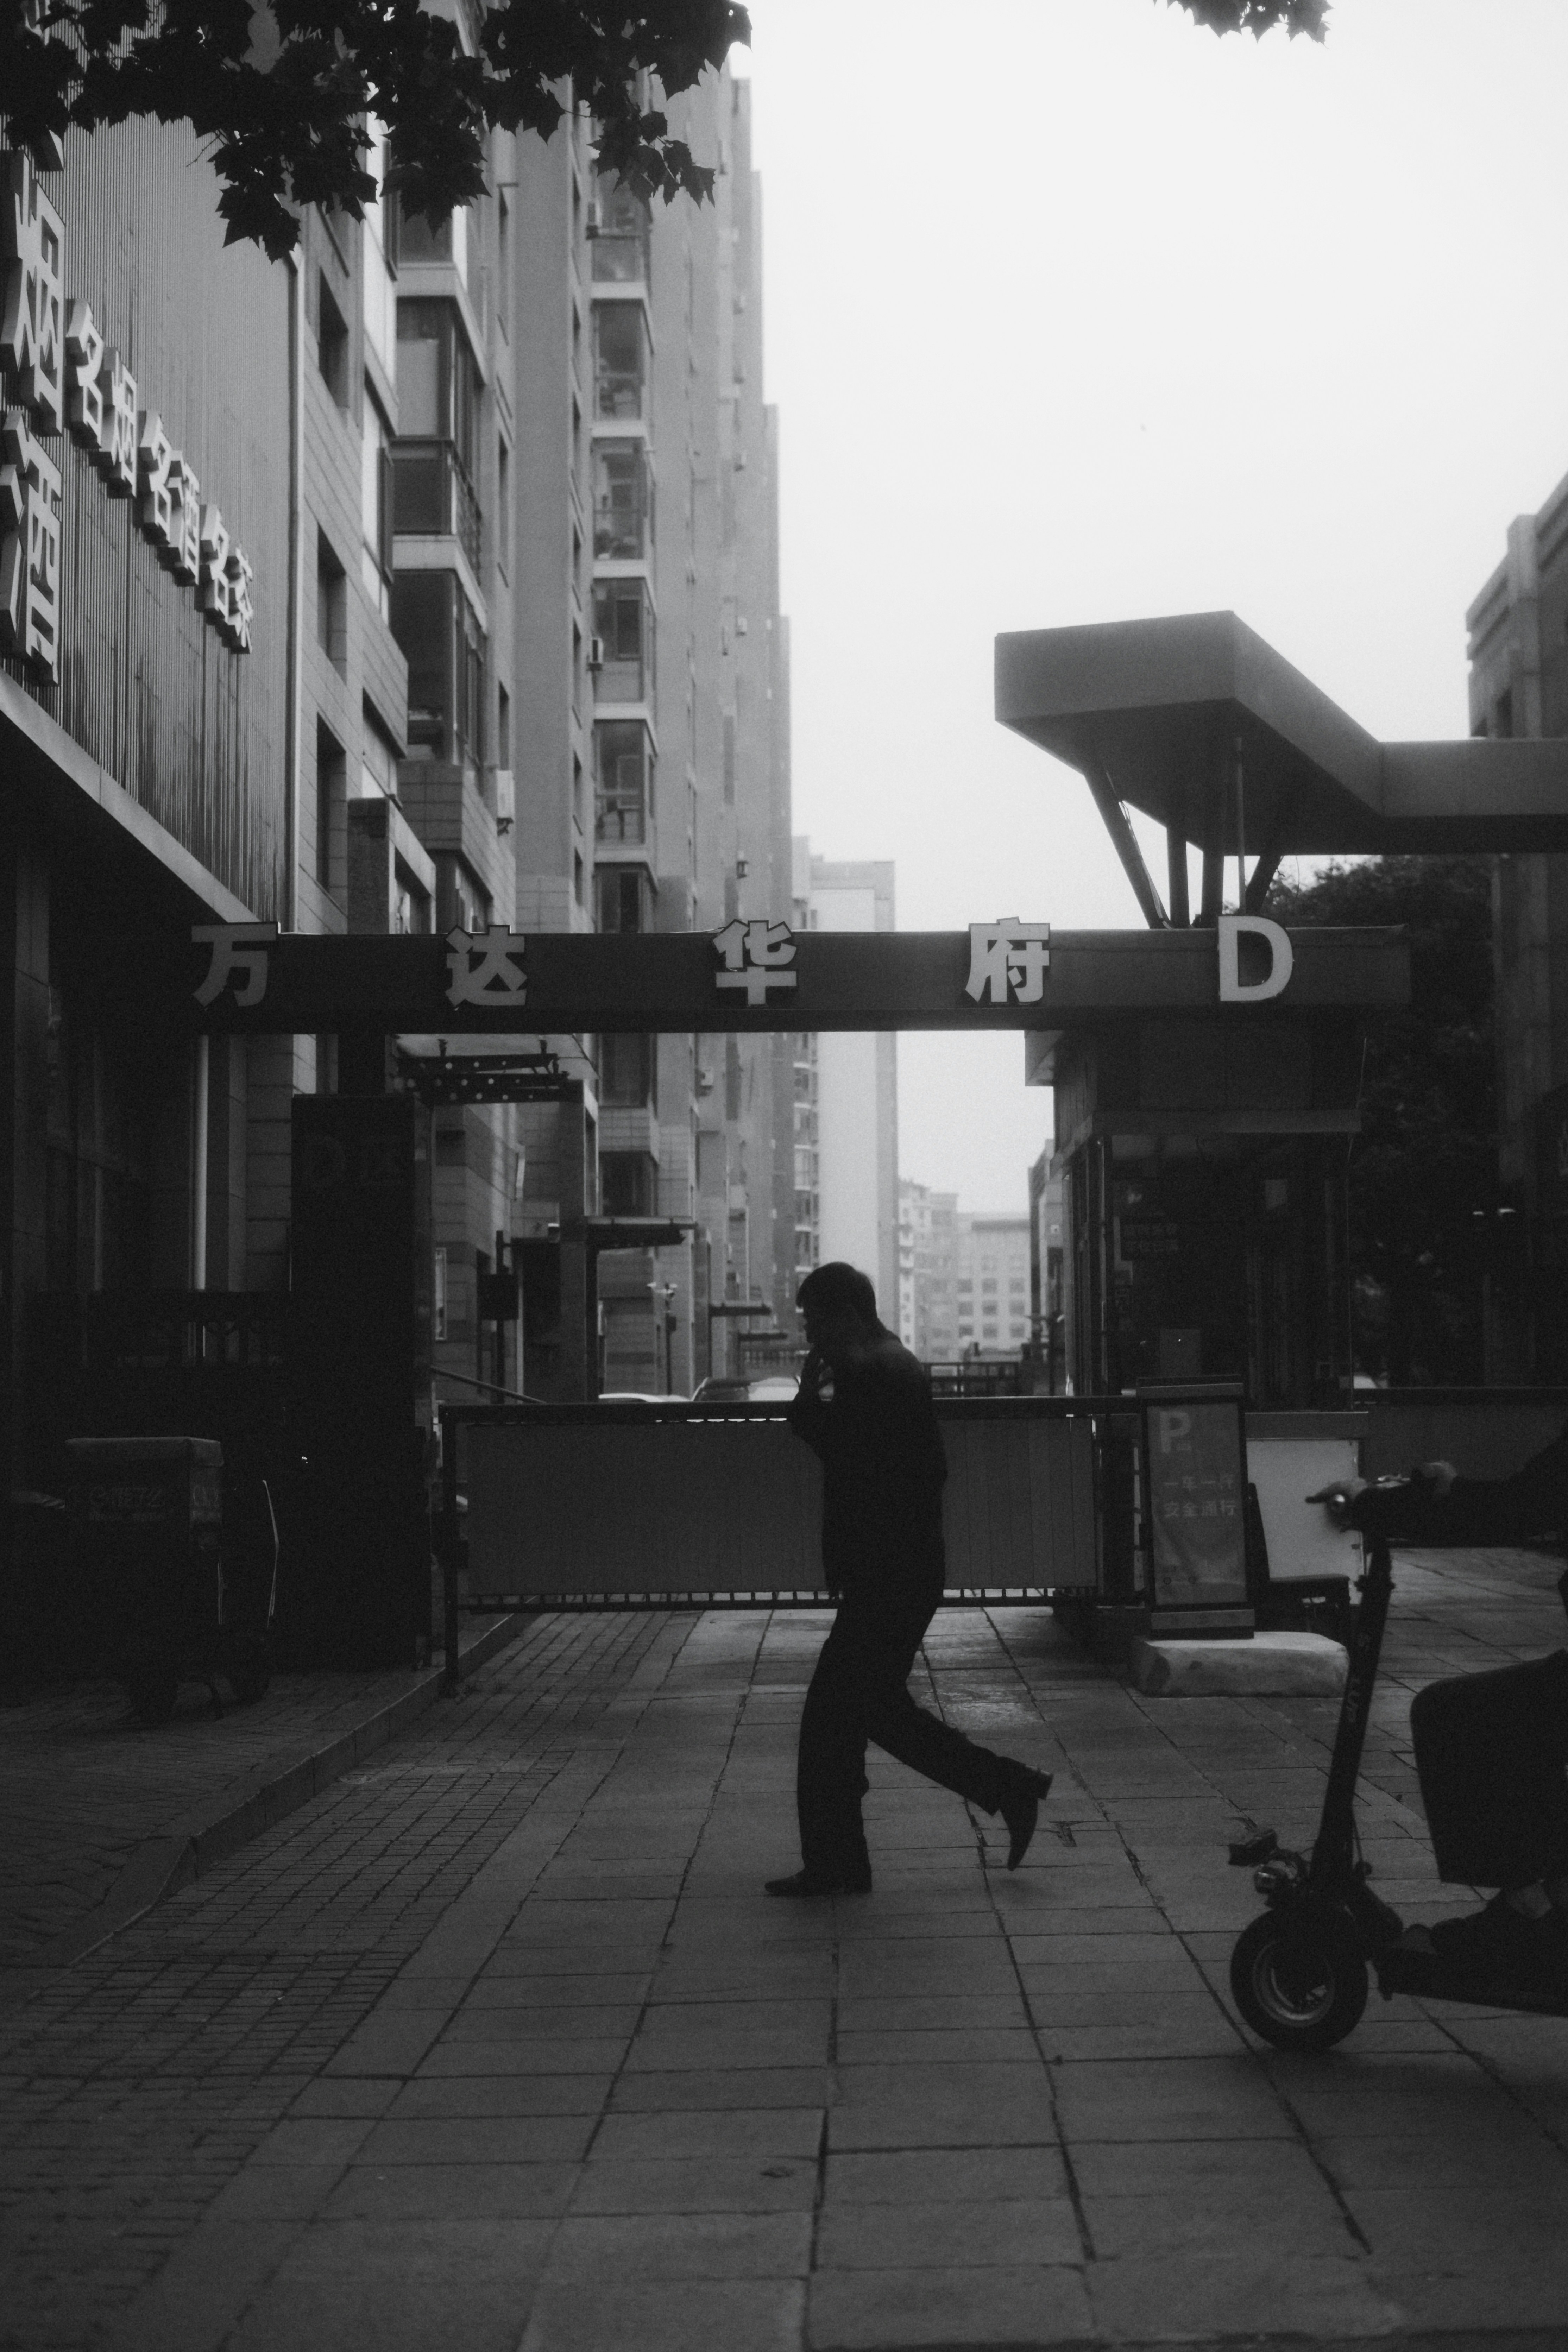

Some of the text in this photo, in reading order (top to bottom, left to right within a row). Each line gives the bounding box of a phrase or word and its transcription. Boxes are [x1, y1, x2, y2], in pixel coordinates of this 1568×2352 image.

[0, 125, 66, 685] 烟酒
[66, 298, 252, 654] 名烟名酒名茶
[1159, 1410, 1192, 1454] P
[1163, 1500, 1237, 1518] 安全通行
